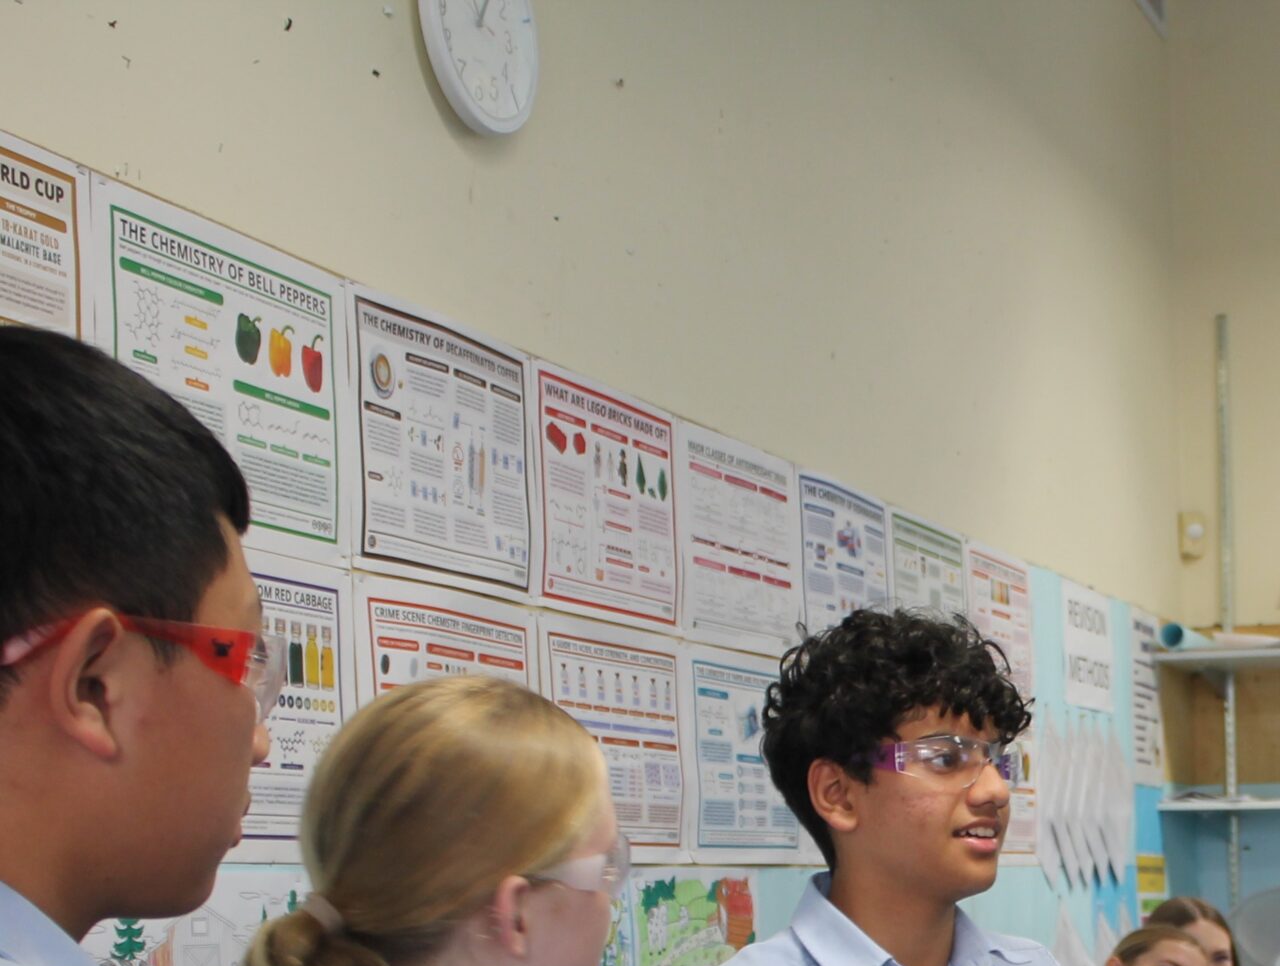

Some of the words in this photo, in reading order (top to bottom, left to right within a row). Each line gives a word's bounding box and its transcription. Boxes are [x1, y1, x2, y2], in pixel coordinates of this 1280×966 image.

[0, 163, 30, 190] RLD
[35, 178, 64, 203] CUP
[40, 232, 60, 251] GOLD
[42, 248, 62, 266] BASE
[120, 218, 146, 244] THE
[151, 232, 224, 275] CHEMISTRY
[228, 263, 244, 282] OF
[248, 271, 275, 296] BELL
[279, 283, 326, 316] PEPPERS
[363, 312, 378, 329] THE
[380, 319, 431, 346] CHEMISTRY
[433, 337, 444, 351] OF
[446, 340, 496, 373] DECAFFEINATED
[497, 365, 519, 383] COFFEE
[544, 383, 568, 403] WHAT
[571, 393, 585, 410] ARE
[586, 399, 607, 417] LEGO
[607, 407, 632, 428] BRICKS
[633, 417, 653, 436] MADE
[257, 585, 272, 599] OM
[275, 587, 292, 602] RED
[294, 591, 333, 611] CABBAGE
[374, 606, 400, 620] CRIME
[401, 610, 426, 624] SCENE
